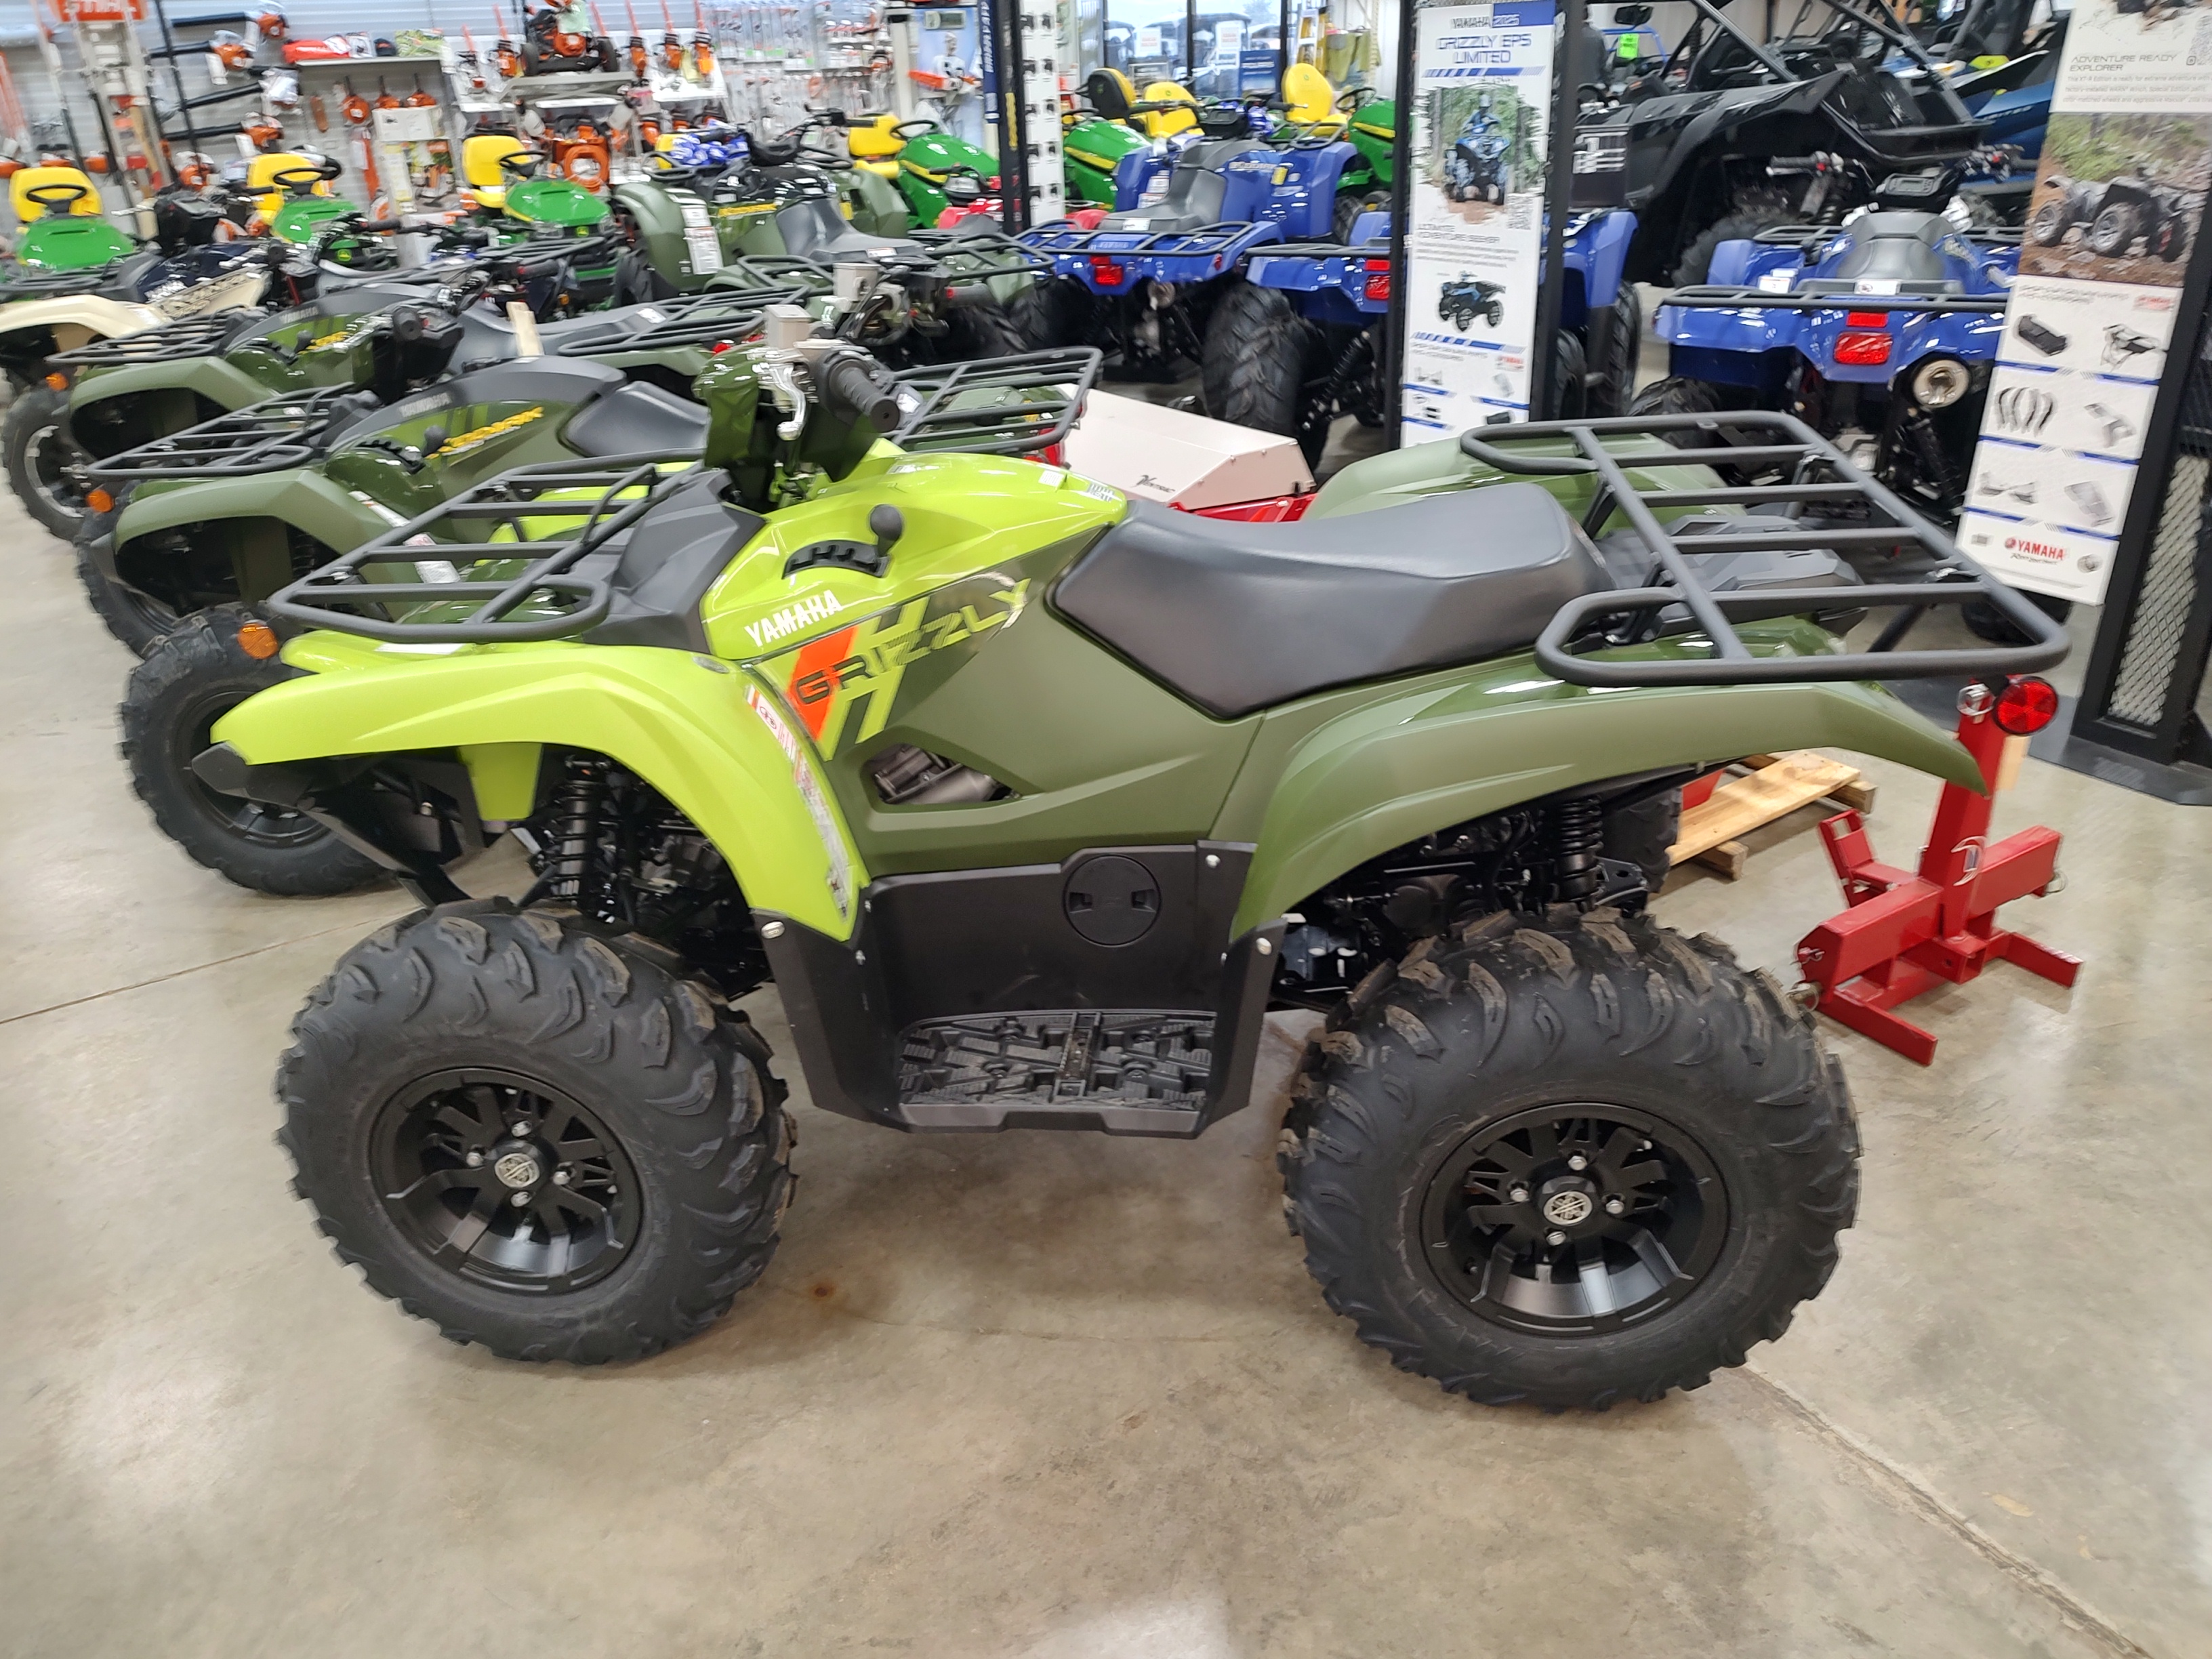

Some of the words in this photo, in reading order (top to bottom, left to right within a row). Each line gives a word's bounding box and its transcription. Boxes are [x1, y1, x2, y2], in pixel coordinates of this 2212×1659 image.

[1436, 35, 1498, 50] GRIZZLY
[1502, 33, 1532, 47] EPS
[1454, 50, 1511, 64] LIMITED
[2071, 55, 2137, 63] ADVENTURE
[2139, 54, 2177, 62] READY
[2069, 64, 2124, 72] EXPLORER
[2018, 539, 2064, 561] YAMAHA
[743, 589, 844, 648] YAMAHA
[796, 577, 1031, 705] GRIZZLY
